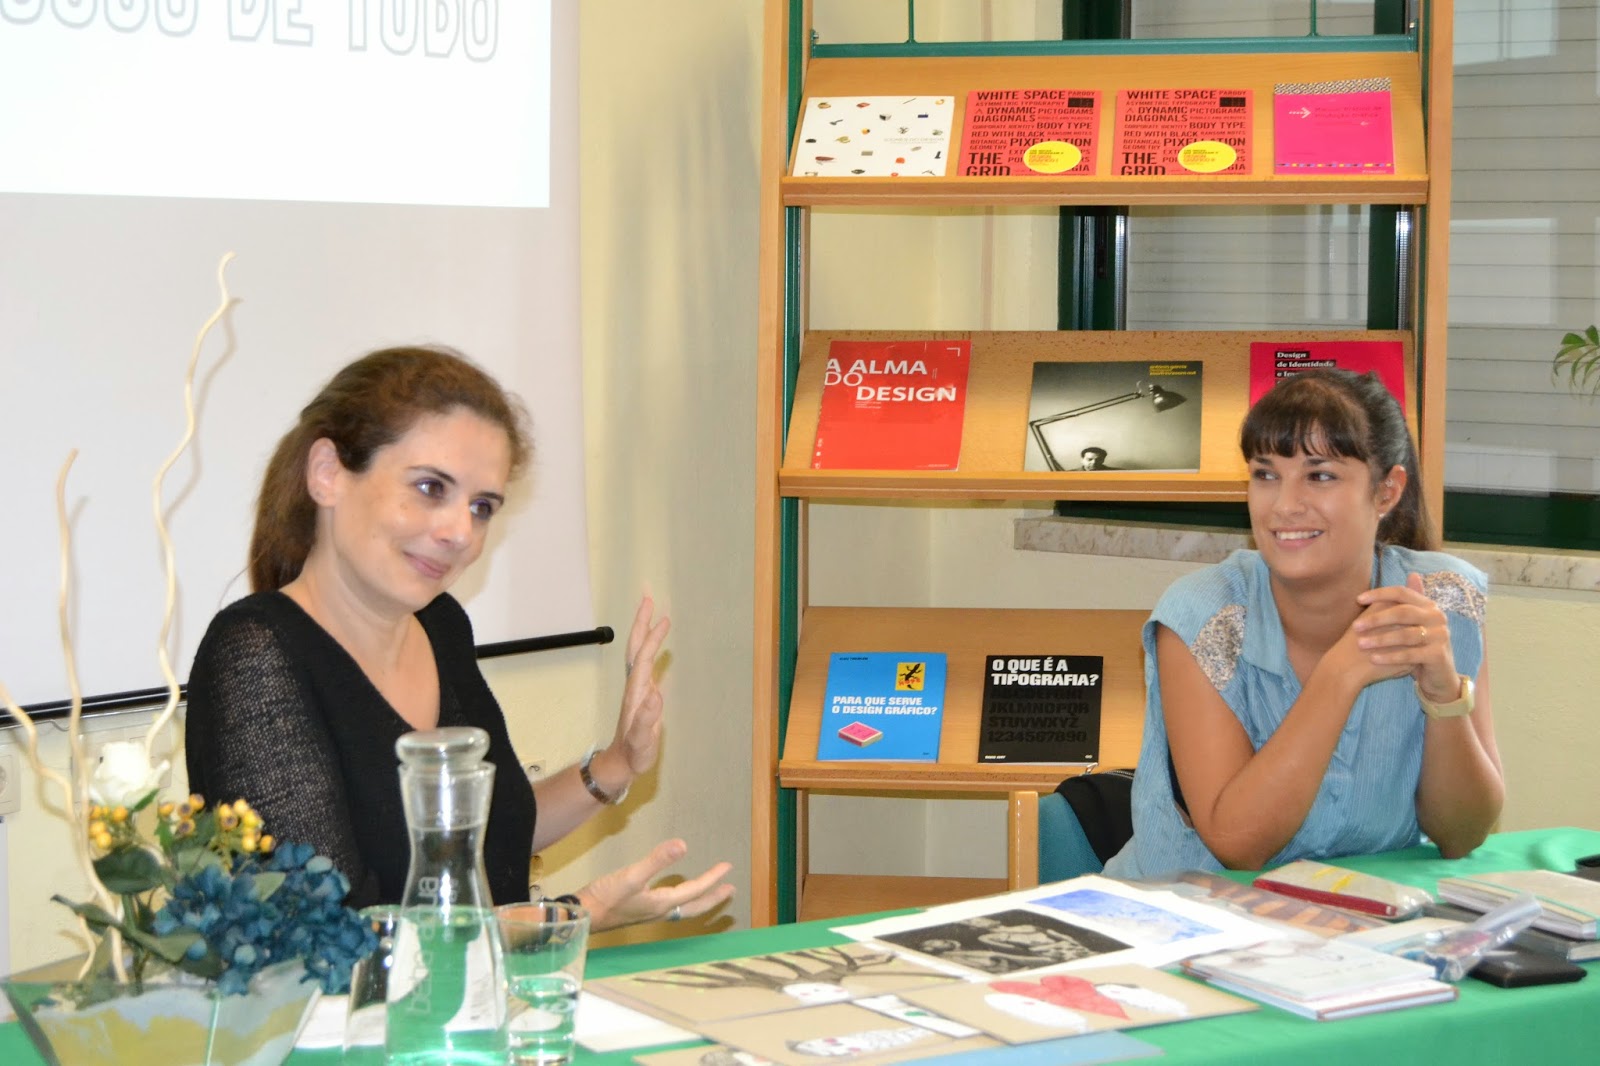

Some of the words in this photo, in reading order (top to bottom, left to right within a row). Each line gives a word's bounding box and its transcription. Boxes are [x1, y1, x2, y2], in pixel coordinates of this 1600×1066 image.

[977, 91, 1019, 100] WHITE
[1023, 90, 1066, 100] SPACE
[1127, 90, 1169, 100] WHITE
[1174, 90, 1217, 100] SPACE
[986, 106, 1036, 115] DYNAMIC
[1138, 106, 1188, 114] DYNAMIC
[973, 115, 1036, 123] DIAGONALS
[1124, 114, 1188, 122] DIAGONALS
[1036, 122, 1064, 130] BODY
[1067, 122, 1093, 130] TYPE
[1010, 138, 1092, 147] PIXETION
[1163, 137, 1246, 147] PIXETION
[968, 152, 1003, 165] THE
[1121, 152, 1157, 165] THE
[966, 165, 1011, 176] GRID
[1120, 165, 1166, 176] GRID
[1277, 351, 1307, 359] Design
[826, 358, 842, 373] A
[849, 359, 928, 375] ALMA
[824, 371, 864, 386] DO
[856, 386, 957, 402] DESIGN
[992, 659, 1005, 671] O
[1007, 659, 1041, 673] QUE
[1043, 657, 1054, 671] É
[1055, 659, 1069, 671] A
[991, 673, 1099, 686] TIPOGRAFIA?
[833, 696, 862, 704] PARA
[864, 697, 886, 706] QUE
[888, 697, 923, 706] SERVE
[832, 706, 840, 714] O
[842, 706, 882, 714] DESIGN
[884, 705, 938, 715] GRÁFICO?
